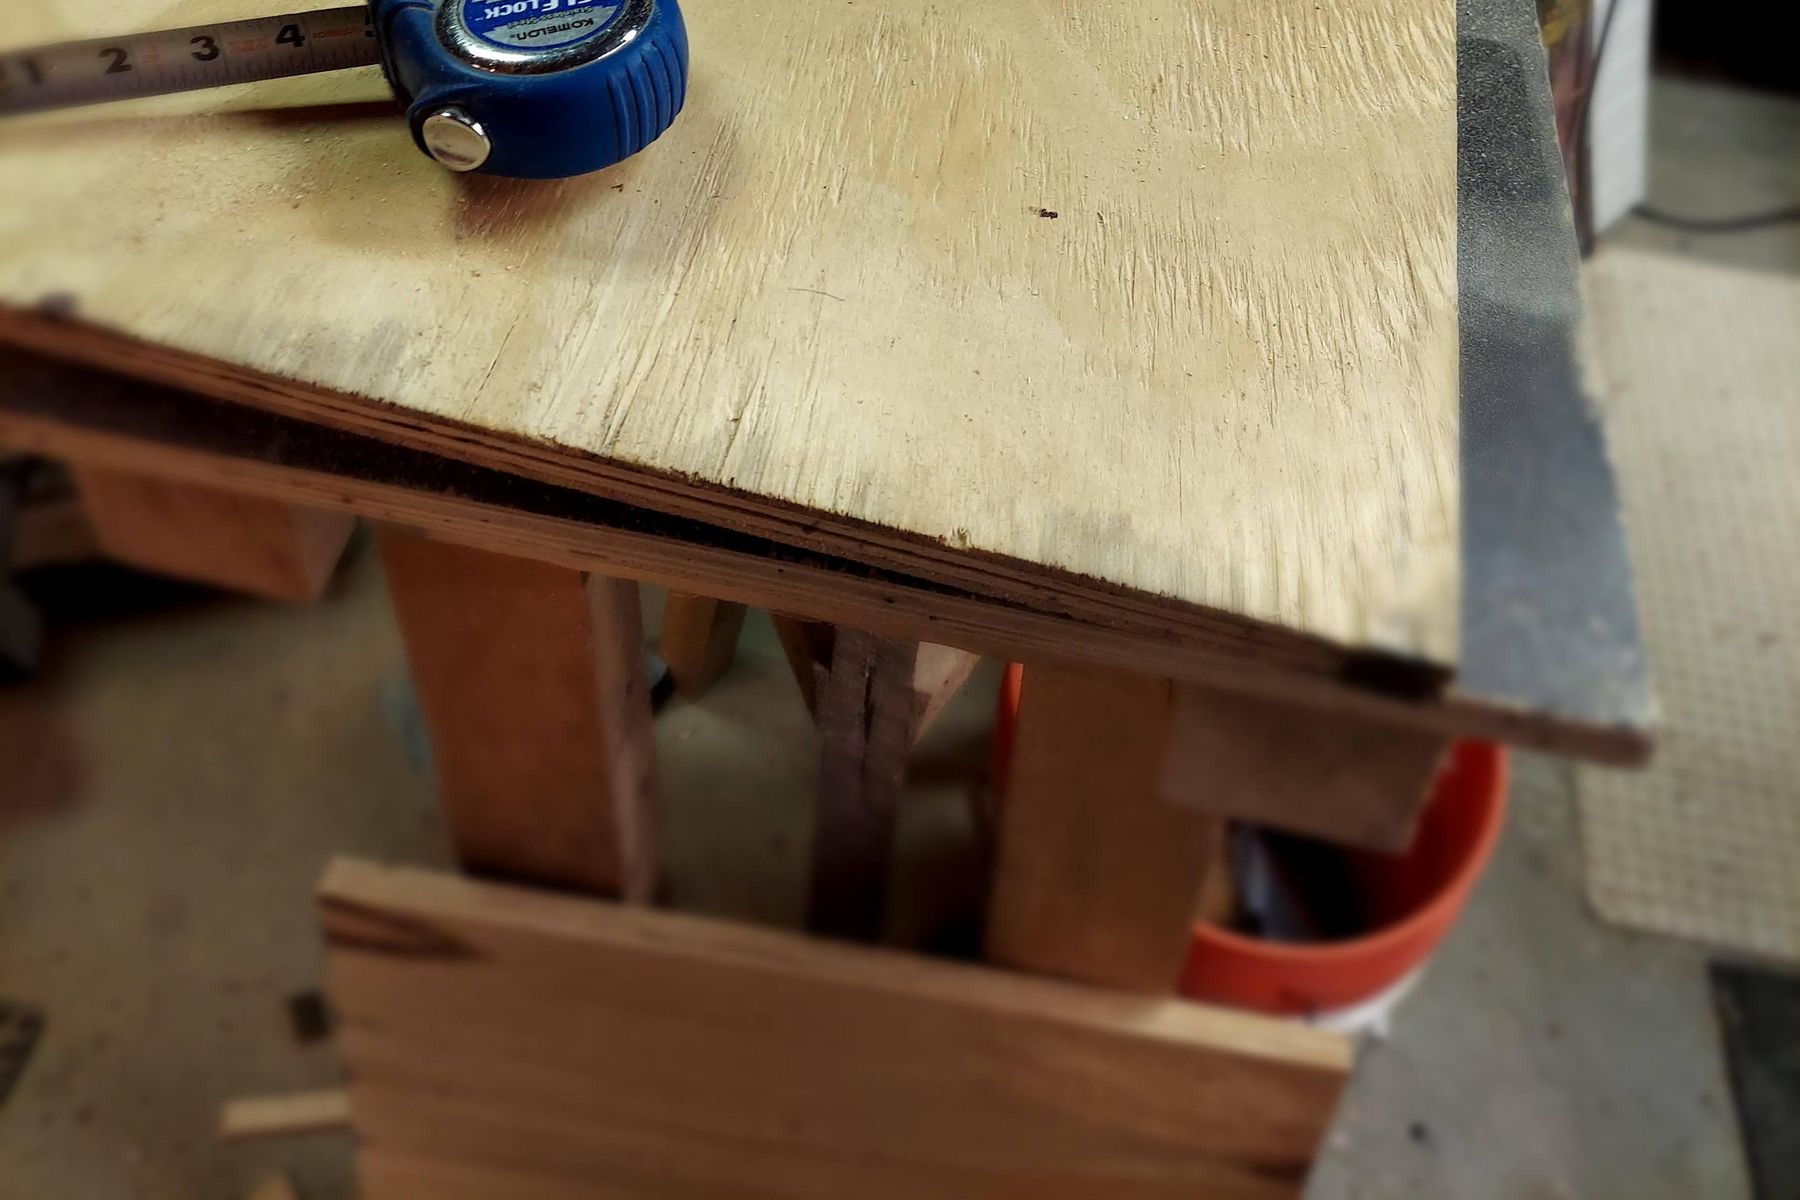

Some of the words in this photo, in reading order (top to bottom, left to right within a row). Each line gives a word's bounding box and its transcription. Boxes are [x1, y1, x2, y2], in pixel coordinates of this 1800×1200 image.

[517, 17, 594, 41] KOMELON
[98, 47, 132, 74] 2
[190, 35, 220, 62] 3
[275, 23, 305, 48] 4
